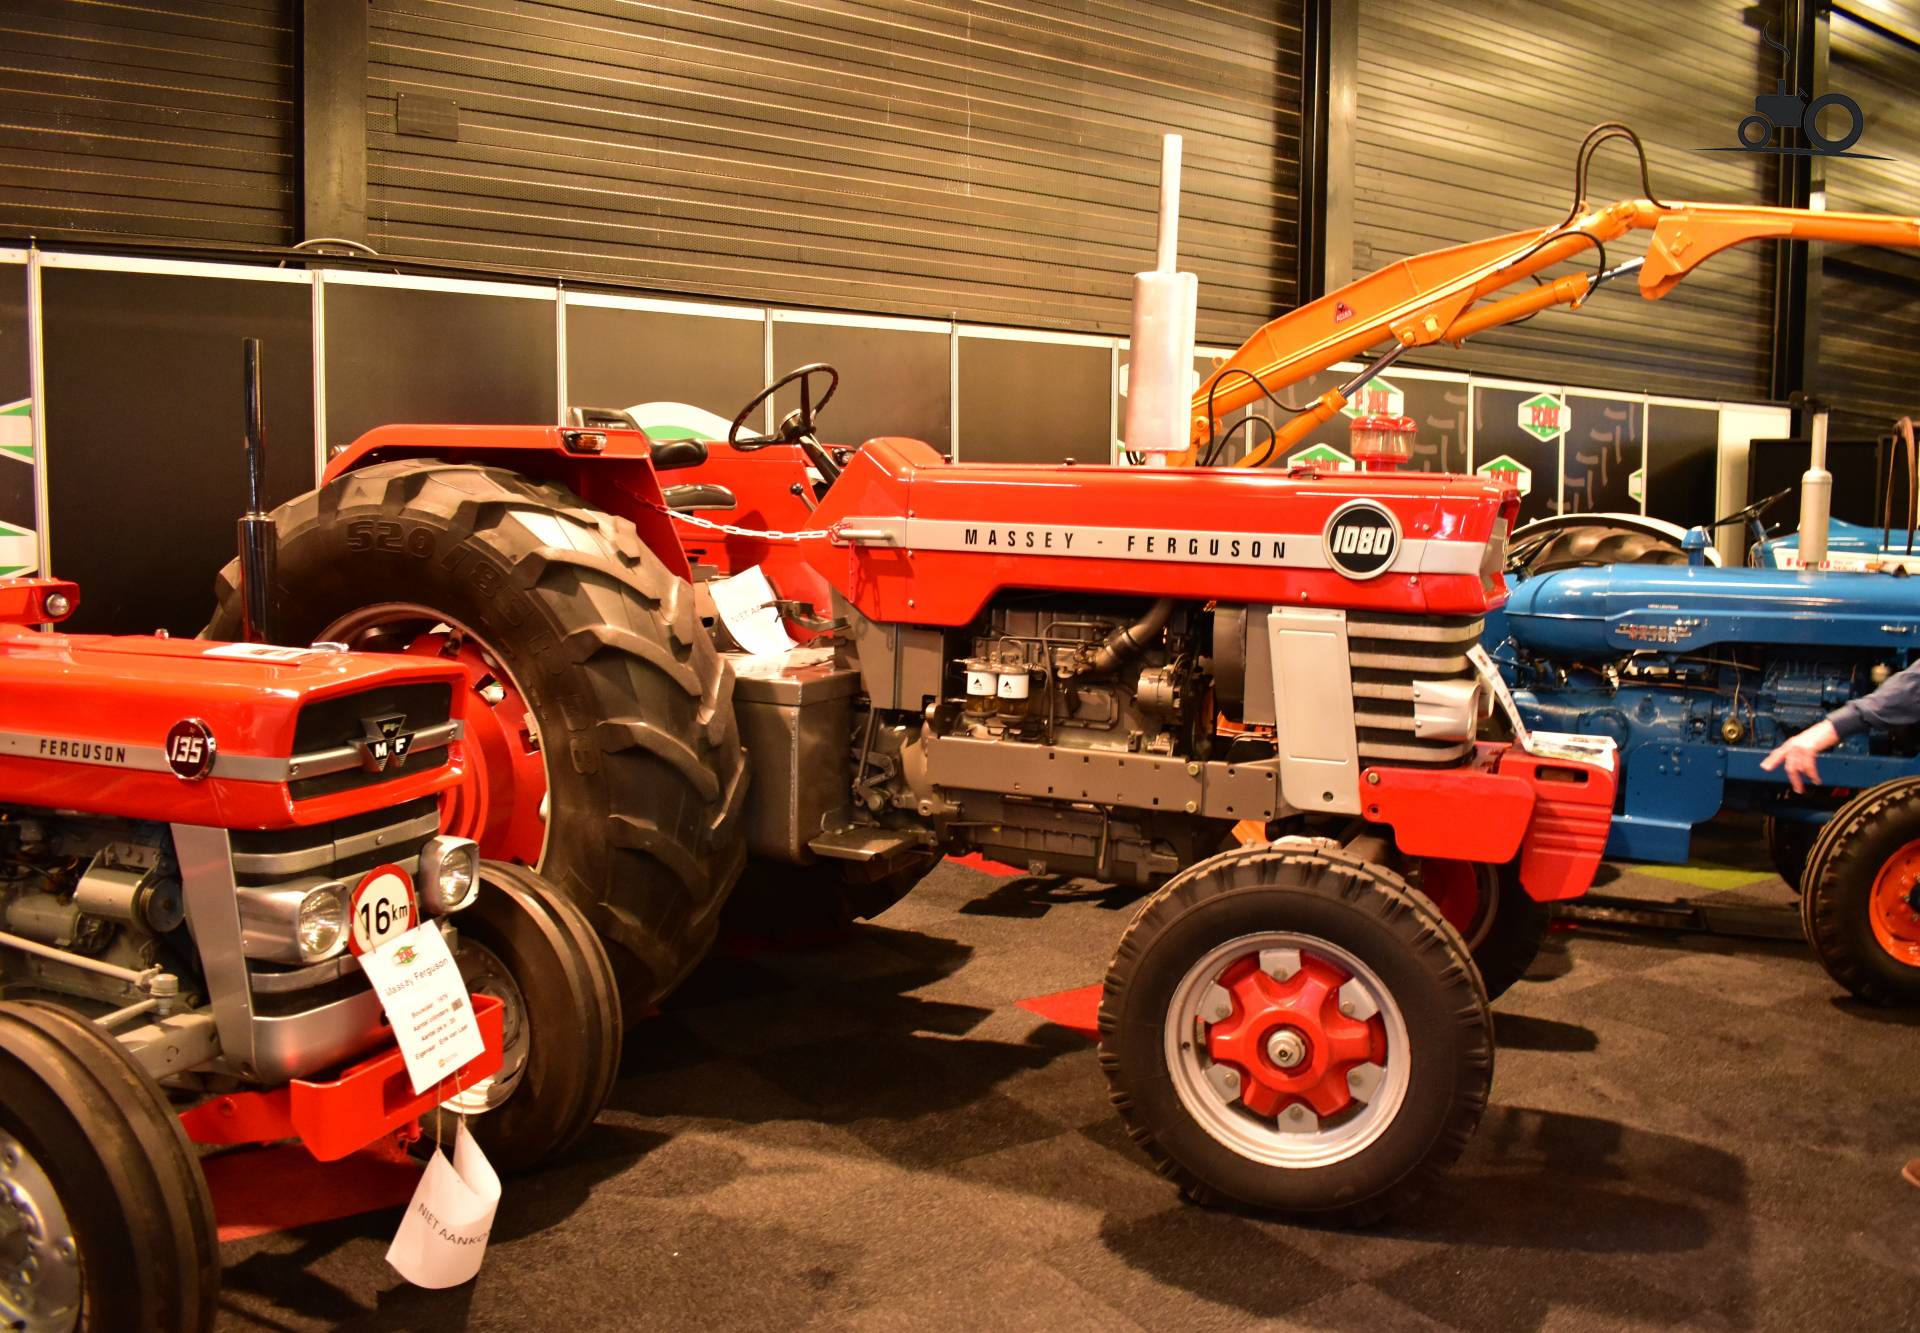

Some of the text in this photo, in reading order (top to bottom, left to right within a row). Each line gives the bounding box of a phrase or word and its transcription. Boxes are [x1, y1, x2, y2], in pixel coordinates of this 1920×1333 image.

[964, 527, 1075, 550] MASSEY
[1127, 534, 1286, 560] FERGUSON
[1332, 524, 1392, 556] 1080
[40, 738, 126, 763] FERGUSON
[171, 735, 204, 764] 135
[360, 897, 408, 941] 16 km
[413, 958, 449, 982] Ferguson
[418, 1203, 440, 1230] NIET
